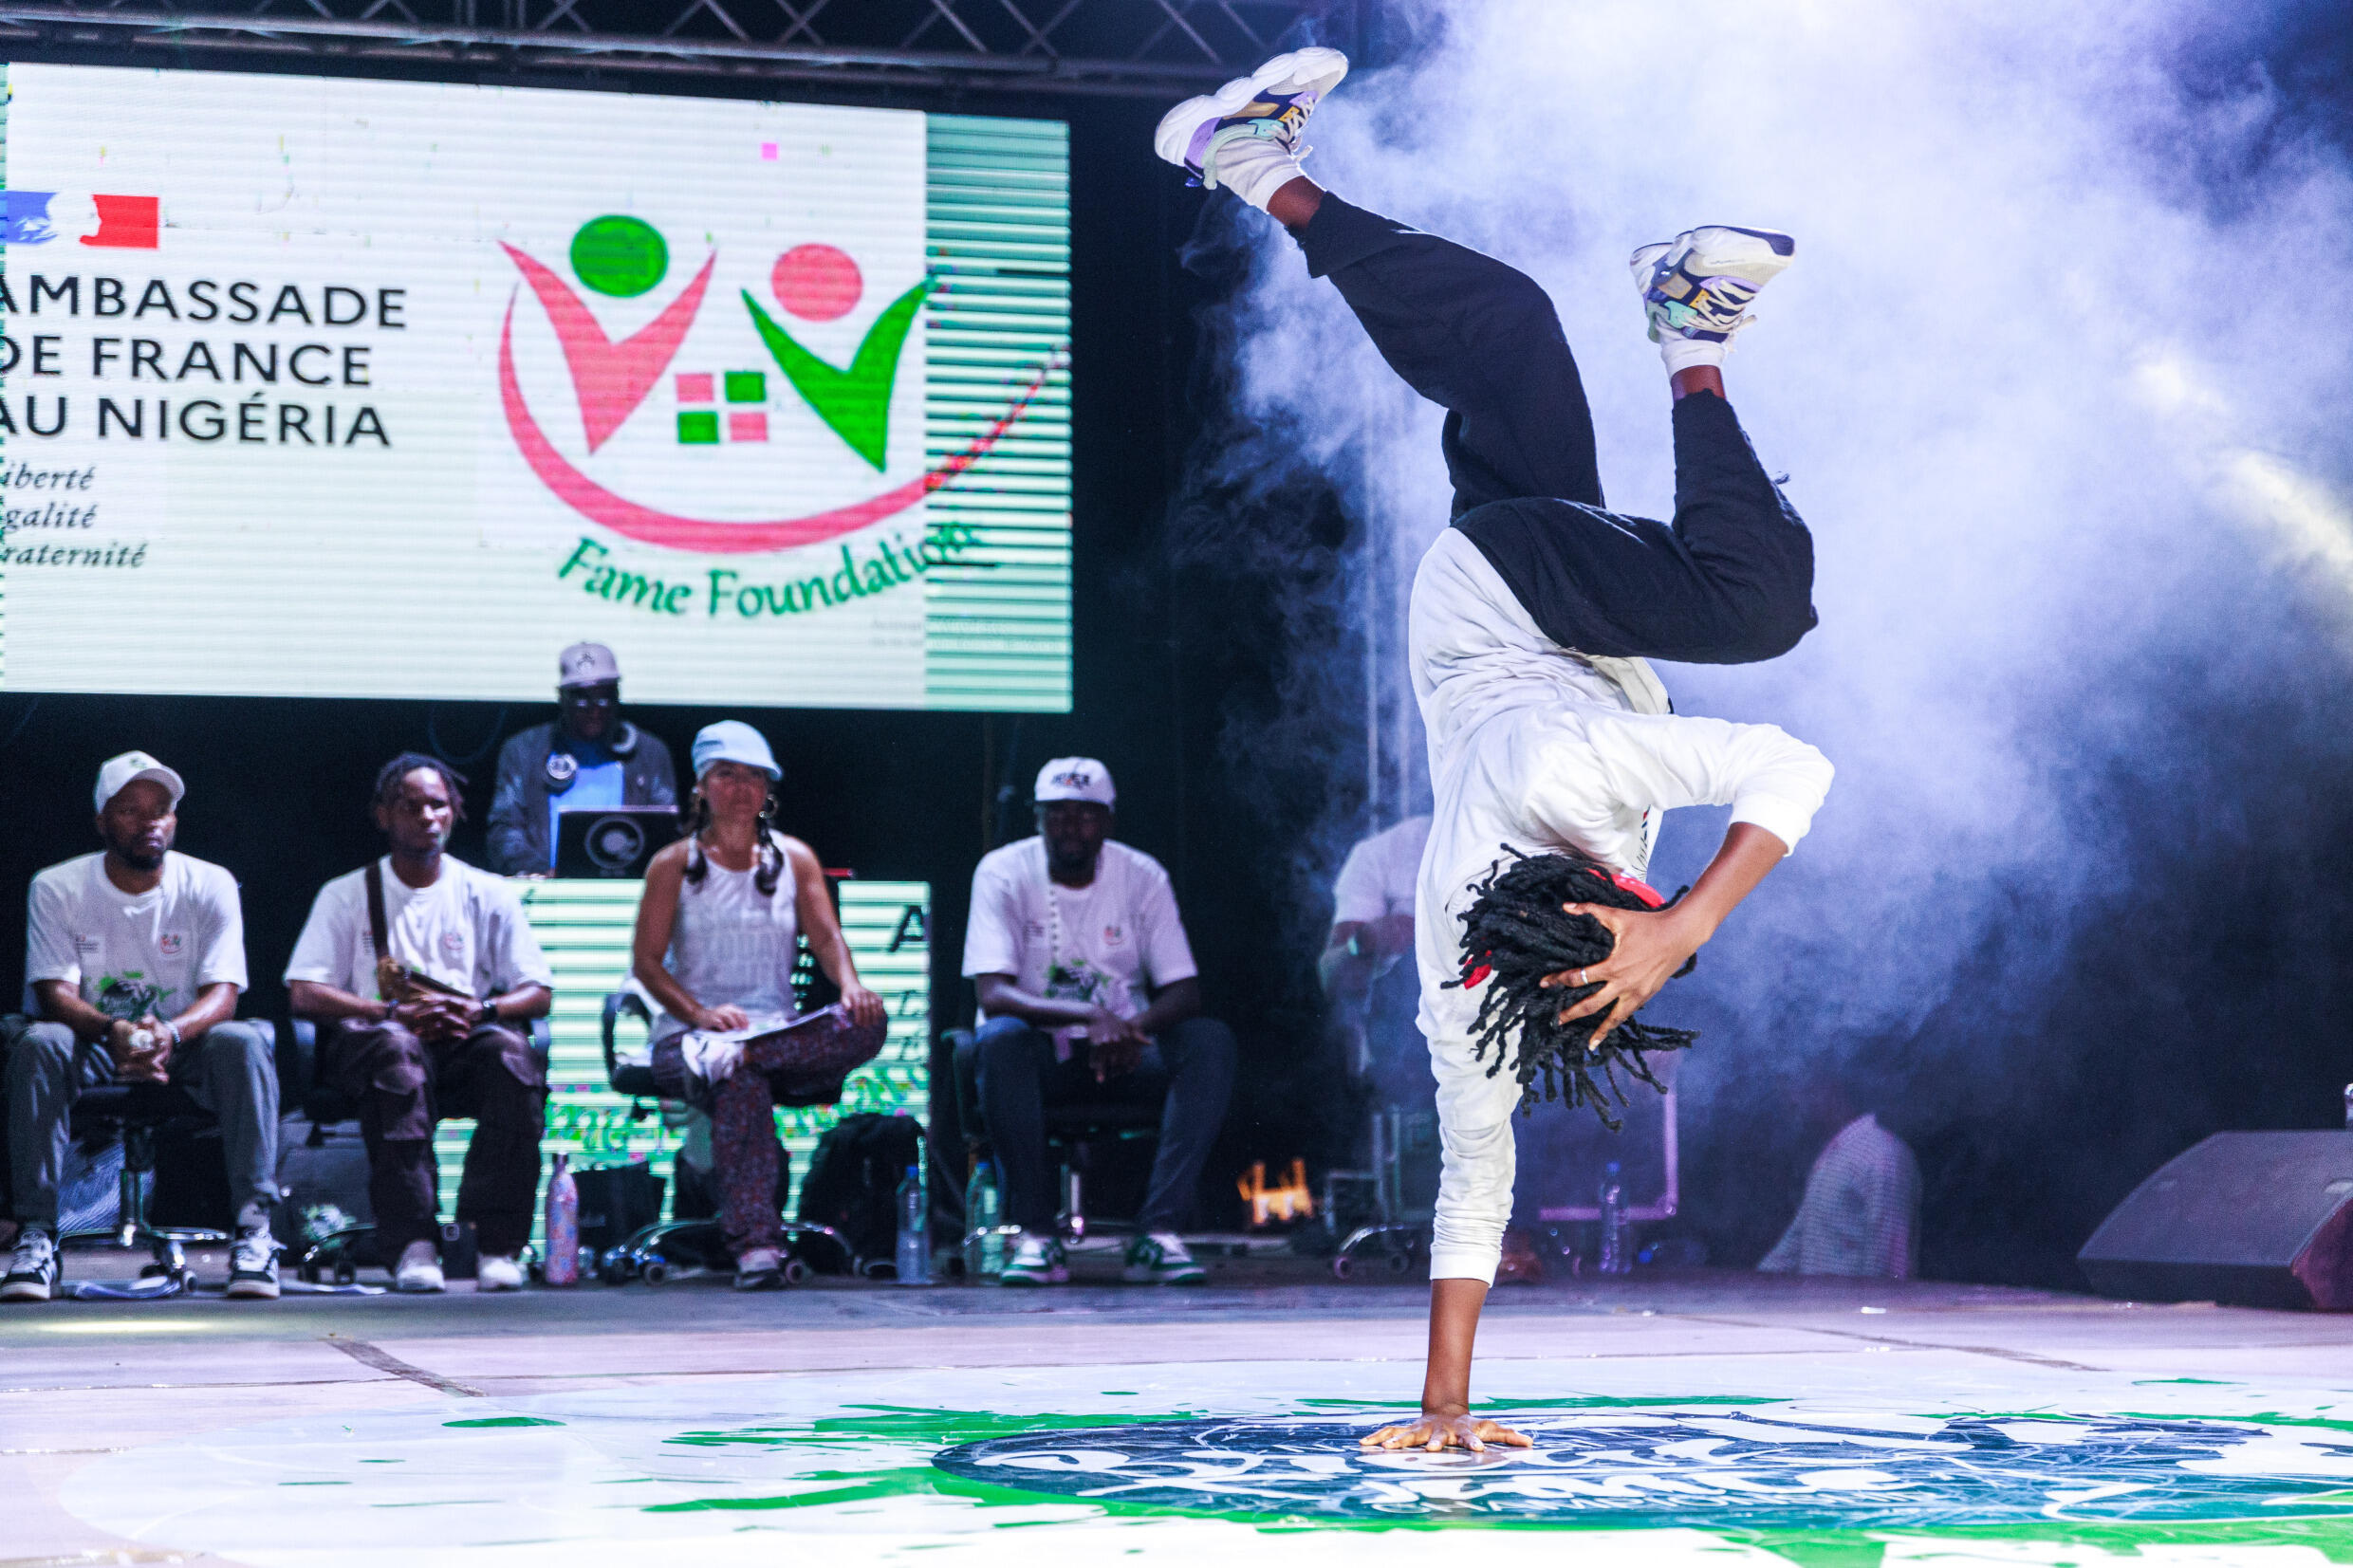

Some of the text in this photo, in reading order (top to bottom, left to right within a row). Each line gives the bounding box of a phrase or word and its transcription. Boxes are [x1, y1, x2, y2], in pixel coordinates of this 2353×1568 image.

[93, 337, 372, 386] FRANCE
[98, 391, 391, 447] NIGÉRIA
[0, 461, 97, 490] iberté
[0, 501, 99, 533] galité
[0, 542, 149, 568] raternité
[558, 536, 694, 616] Fame
[1370, 1491, 1938, 1514] CHAMPIONSHIP
